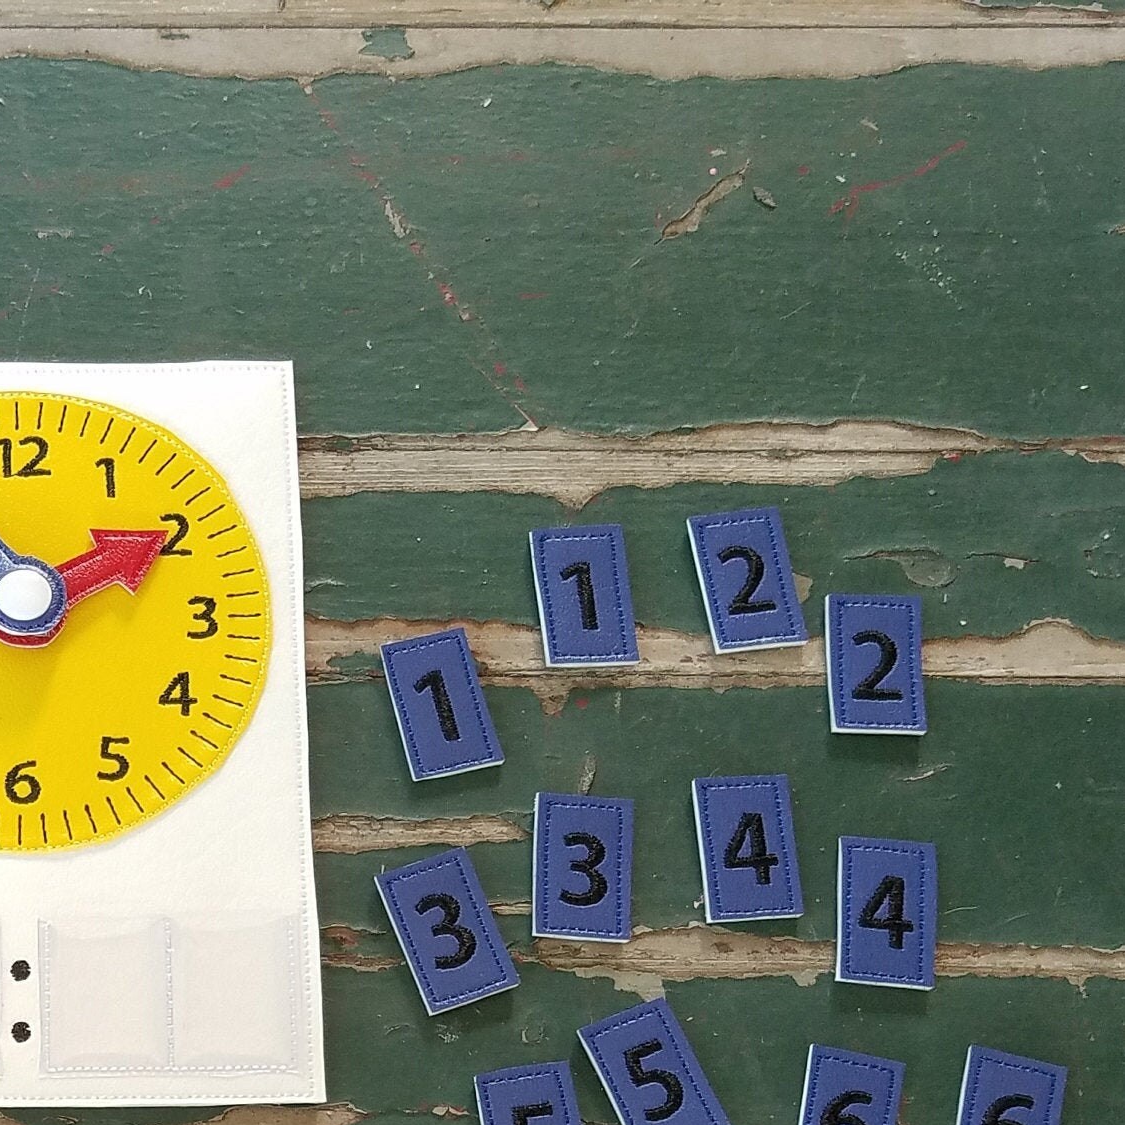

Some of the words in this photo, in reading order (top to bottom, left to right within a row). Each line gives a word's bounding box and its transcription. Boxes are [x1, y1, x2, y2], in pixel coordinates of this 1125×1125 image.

[94, 458, 116, 498] 1
[159, 513, 193, 556] 2
[559, 561, 599, 631] 1
[717, 545, 777, 616] 2
[187, 596, 218, 639] 3
[158, 671, 198, 716] 4
[851, 630, 904, 702] 2
[413, 669, 461, 742] 1
[4, 760, 42, 804] 6
[97, 736, 130, 781] 5
[558, 831, 608, 907] 3
[723, 812, 779, 886] 4
[414, 892, 477, 970] 3
[857, 875, 914, 950] 4
[622, 1038, 684, 1122] 5
